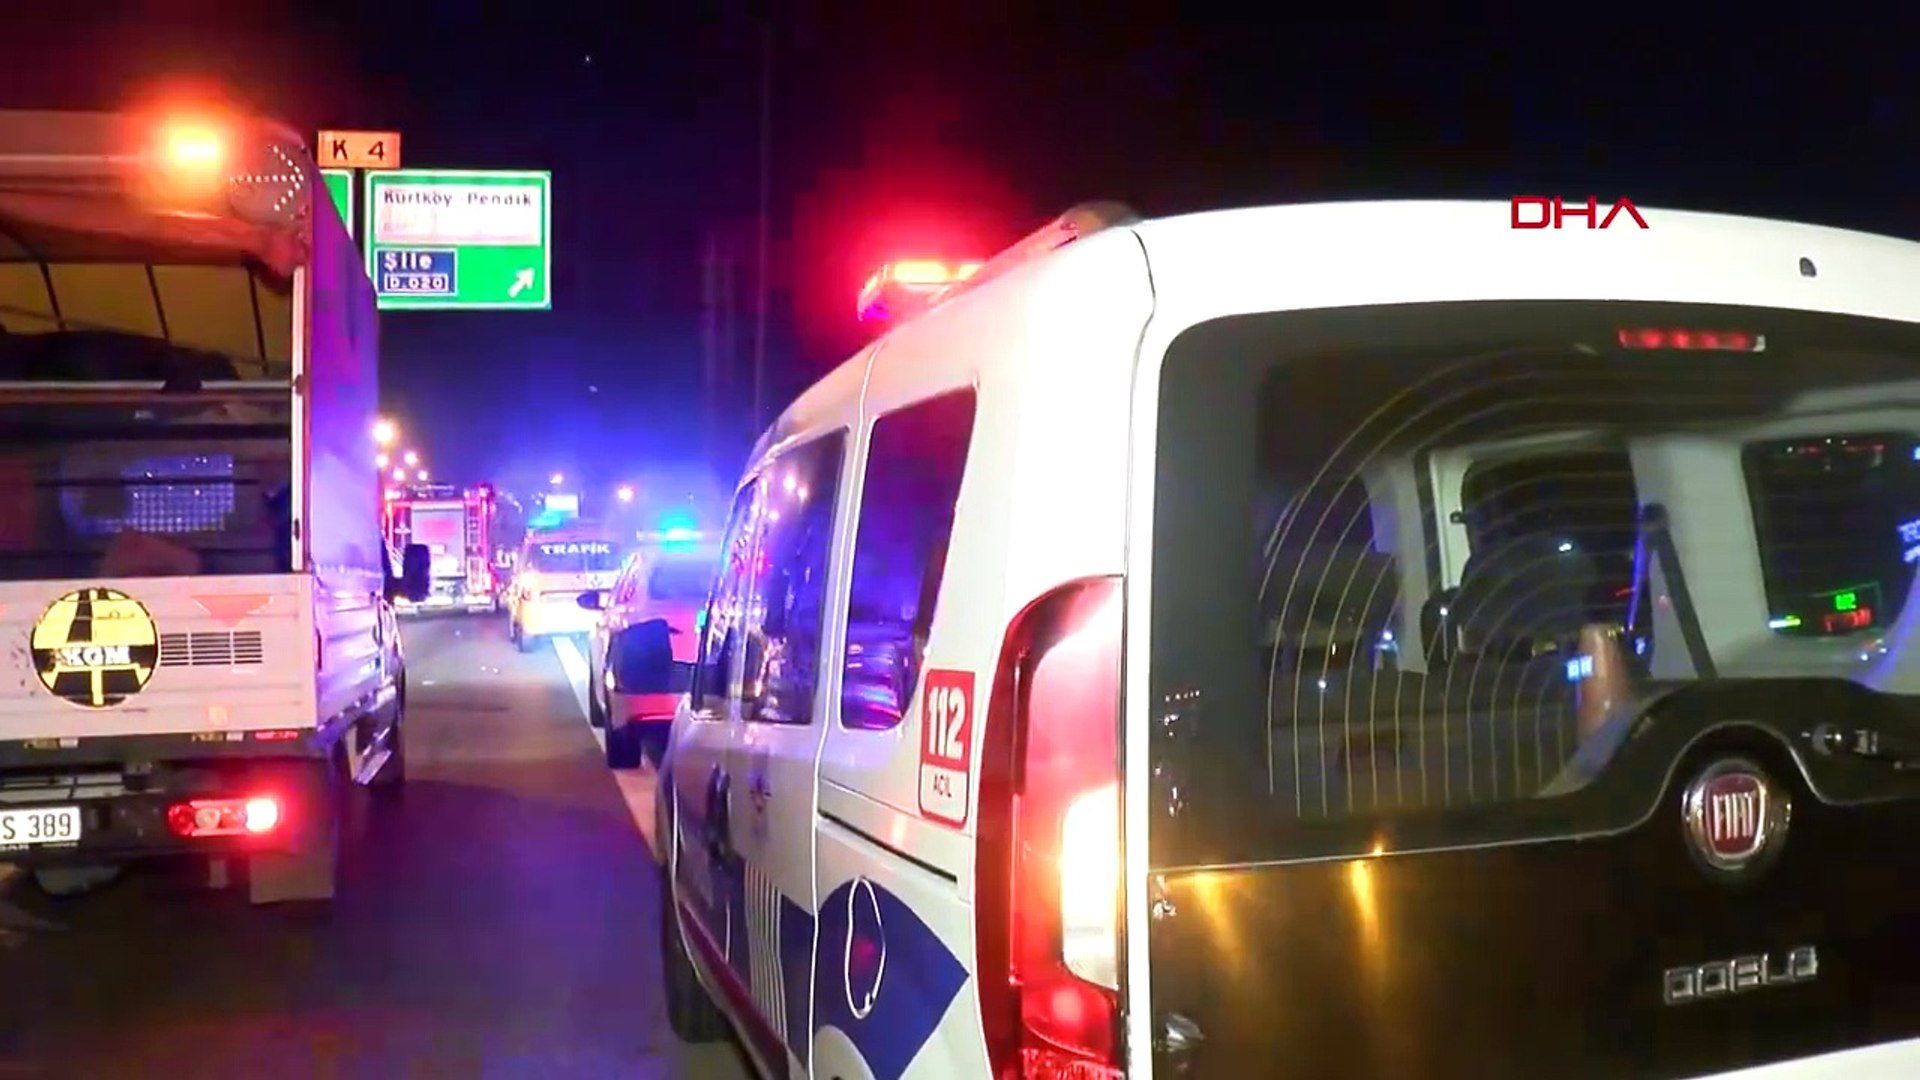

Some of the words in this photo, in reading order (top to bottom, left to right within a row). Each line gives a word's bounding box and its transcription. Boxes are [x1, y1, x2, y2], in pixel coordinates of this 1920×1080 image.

[333, 140, 348, 160] K
[368, 141, 385, 160] 4
[60, 646, 130, 667] KGM
[928, 686, 967, 761] 112
[2, 815, 16, 840] S
[27, 812, 71, 838] 389
[1712, 792, 1757, 841] FIAT
